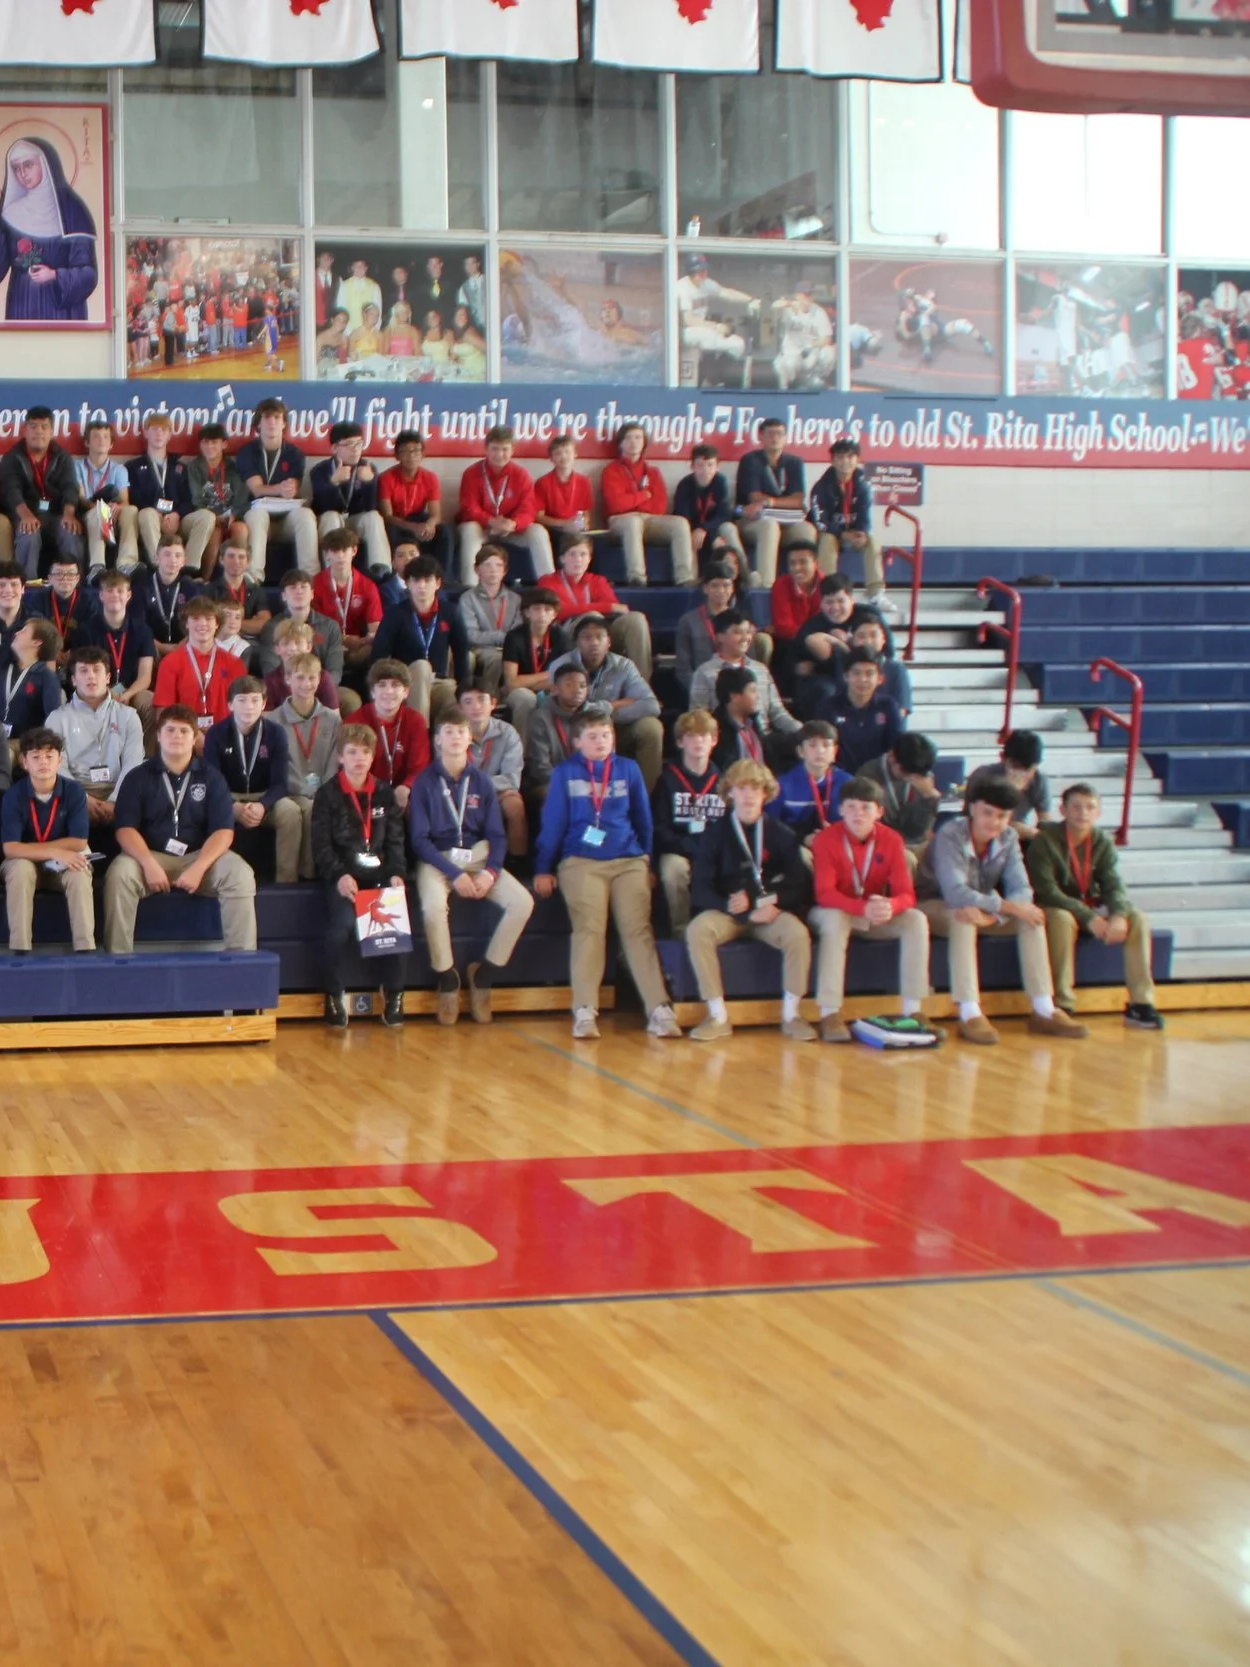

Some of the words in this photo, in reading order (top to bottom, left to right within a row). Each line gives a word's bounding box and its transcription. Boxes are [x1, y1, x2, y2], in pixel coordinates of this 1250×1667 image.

[80, 401, 109, 438] to
[288, 396, 357, 438] we'll
[362, 396, 434, 450] fight
[440, 398, 509, 440] until
[513, 398, 588, 441] we're
[786, 404, 864, 446] here's
[870, 413, 897, 448] to
[900, 407, 943, 449] old
[944, 410, 979, 450] St.
[984, 409, 1040, 451] Rita
[1042, 410, 1104, 462] High
[1107, 411, 1192, 453] School
